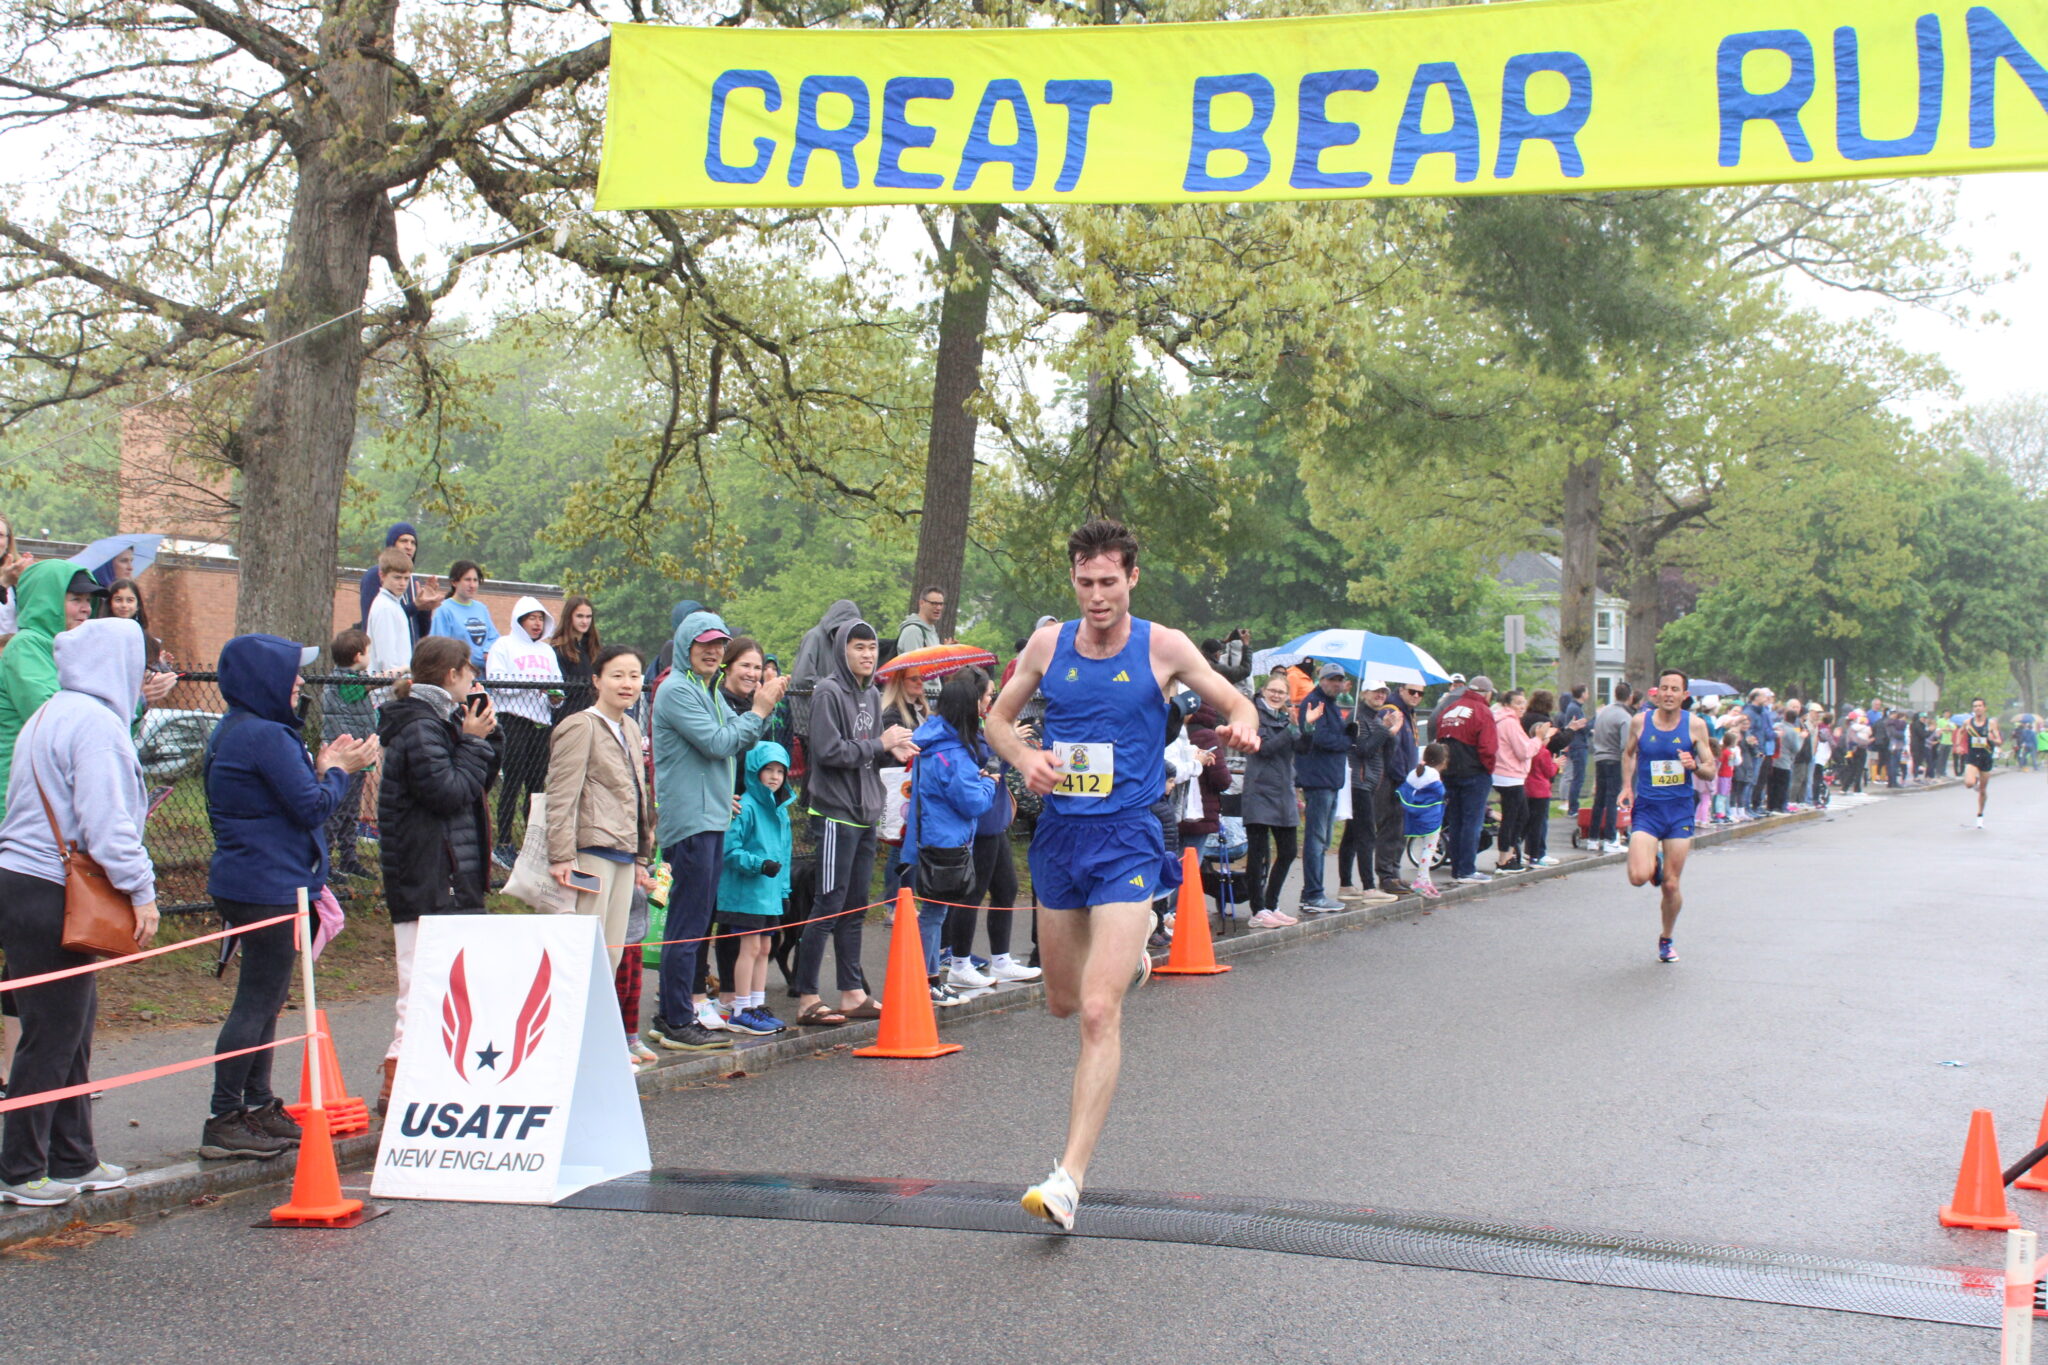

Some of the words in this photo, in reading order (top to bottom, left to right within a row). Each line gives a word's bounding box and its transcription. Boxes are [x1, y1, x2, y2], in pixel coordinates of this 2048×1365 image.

[705, 70, 1112, 191] GREAT
[1183, 51, 1592, 192] BEAR
[1717, 7, 2048, 167] RUN
[1062, 774, 1100, 792] 412
[1658, 774, 1679, 784] 420
[401, 1102, 553, 1140] USATF
[385, 1148, 437, 1168] NEW
[439, 1150, 545, 1172] ENGLAND
